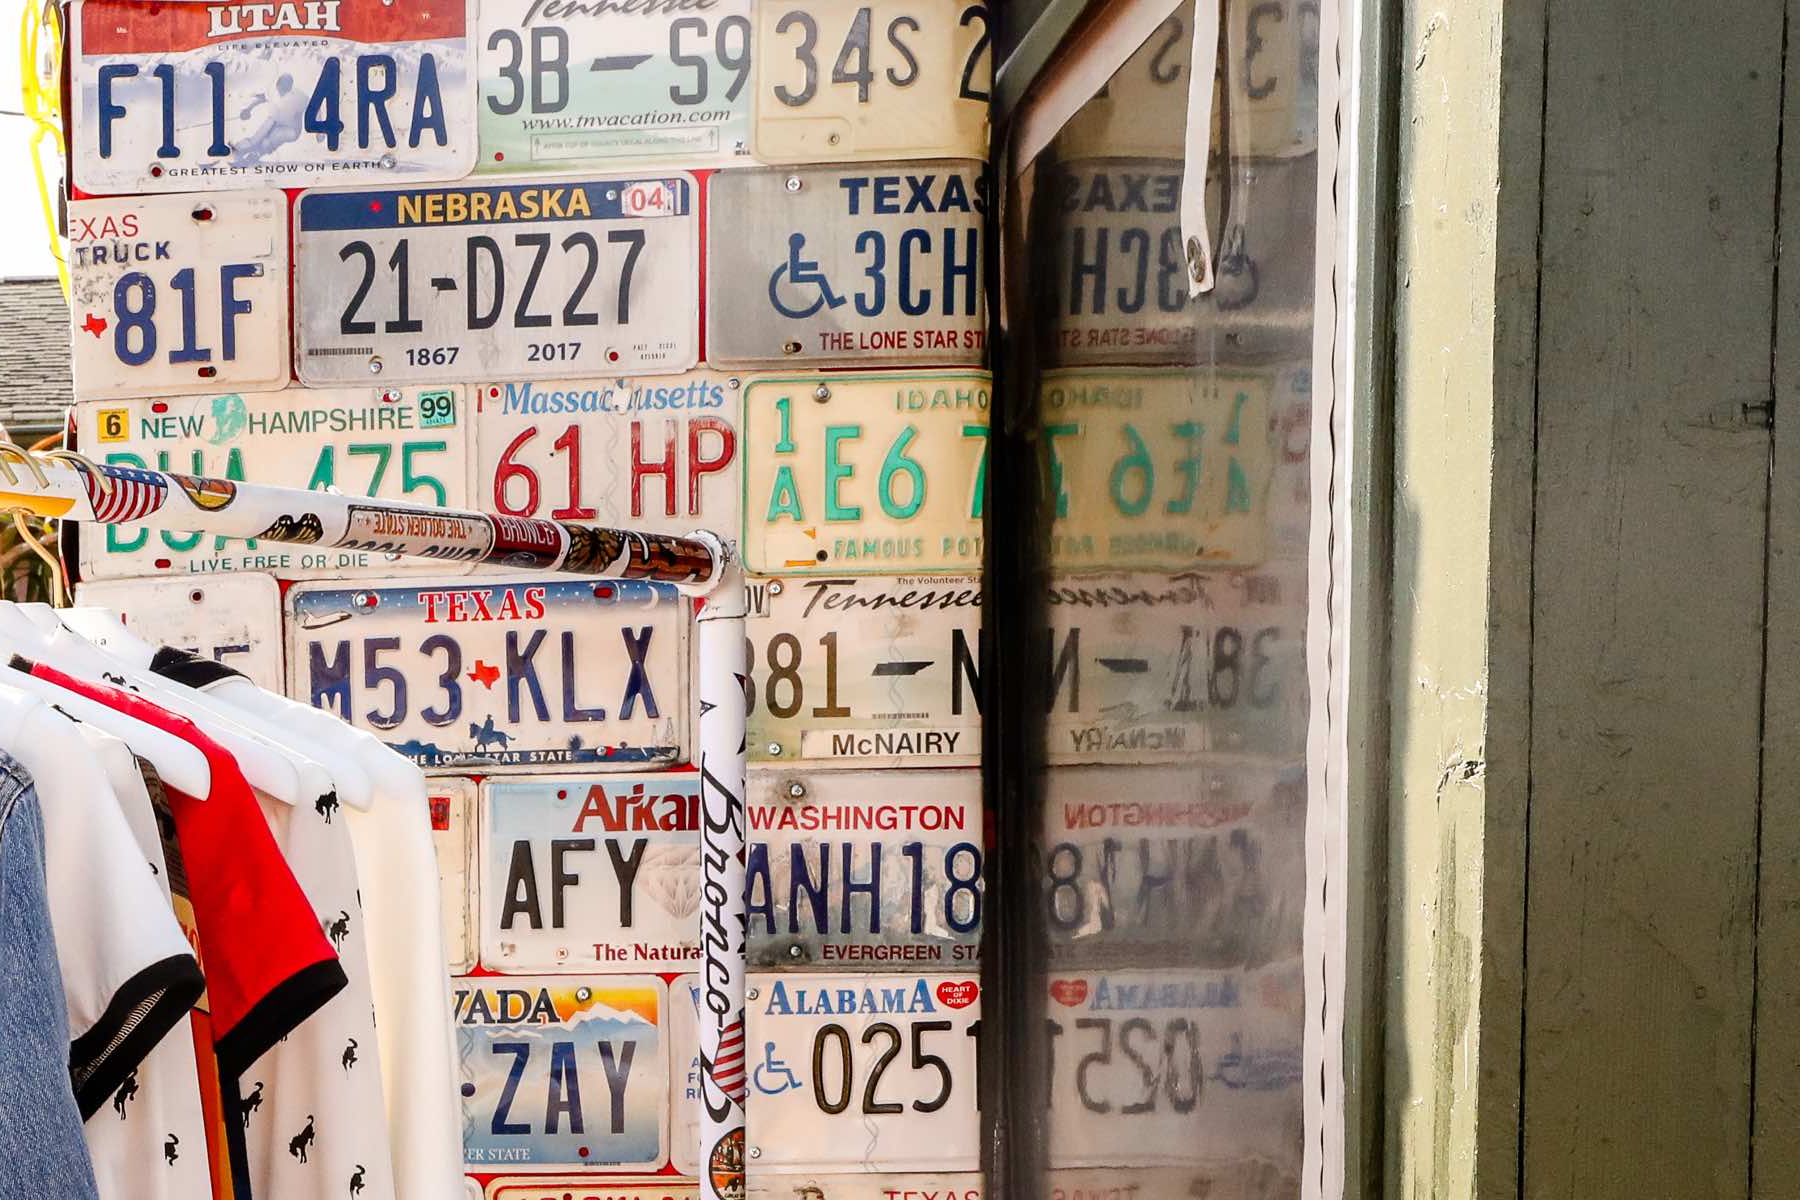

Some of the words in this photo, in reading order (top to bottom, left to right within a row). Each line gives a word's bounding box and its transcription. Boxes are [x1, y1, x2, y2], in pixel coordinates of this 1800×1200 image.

[207, 1, 341, 37] UTAH
[256, 40, 329, 48] ELEVATED
[487, 26, 570, 116] 3B
[99, 63, 231, 159] F11
[304, 53, 448, 153] 4RA
[521, 109, 731, 131] www.tnvacation.com
[168, 165, 245, 177] GREATEST
[253, 164, 300, 175] SNOW
[303, 163, 321, 174] ON
[326, 160, 383, 172] EARTH
[397, 188, 592, 225] NEBRASKA
[631, 187, 664, 211] 04
[75, 241, 171, 264] TRUCK
[854, 227, 979, 318] 3CH
[114, 263, 264, 366] 81F
[819, 331, 854, 352] THE
[859, 330, 908, 351] LONE
[914, 328, 958, 349] STAR
[406, 347, 459, 366] 1867
[528, 343, 582, 362] 2017
[420, 396, 451, 418] 99
[106, 415, 122, 435] 6
[141, 415, 204, 439] NEW
[248, 407, 414, 433] HAMPSHIRE
[494, 423, 598, 520] 61
[630, 415, 735, 518] HP
[833, 538, 923, 559] FAMOUS
[190, 557, 231, 573] LIVE
[238, 556, 291, 570] FREE
[301, 555, 330, 568] OR
[337, 552, 369, 567] DIE
[896, 576, 915, 586] The
[916, 576, 967, 586] Volunteer
[419, 587, 546, 624] TEXAS
[506, 626, 659, 723] KLX
[531, 749, 573, 762] STATE
[832, 732, 963, 756] McNAIRY
[749, 806, 965, 832] WASHINGTON
[500, 838, 648, 929] AFY
[593, 943, 628, 961] The
[823, 944, 942, 961] EVERGREEN
[765, 978, 937, 1016] ALABAMA
[491, 1040, 637, 1136] ZAY
[488, 1147, 531, 1161] STATE
